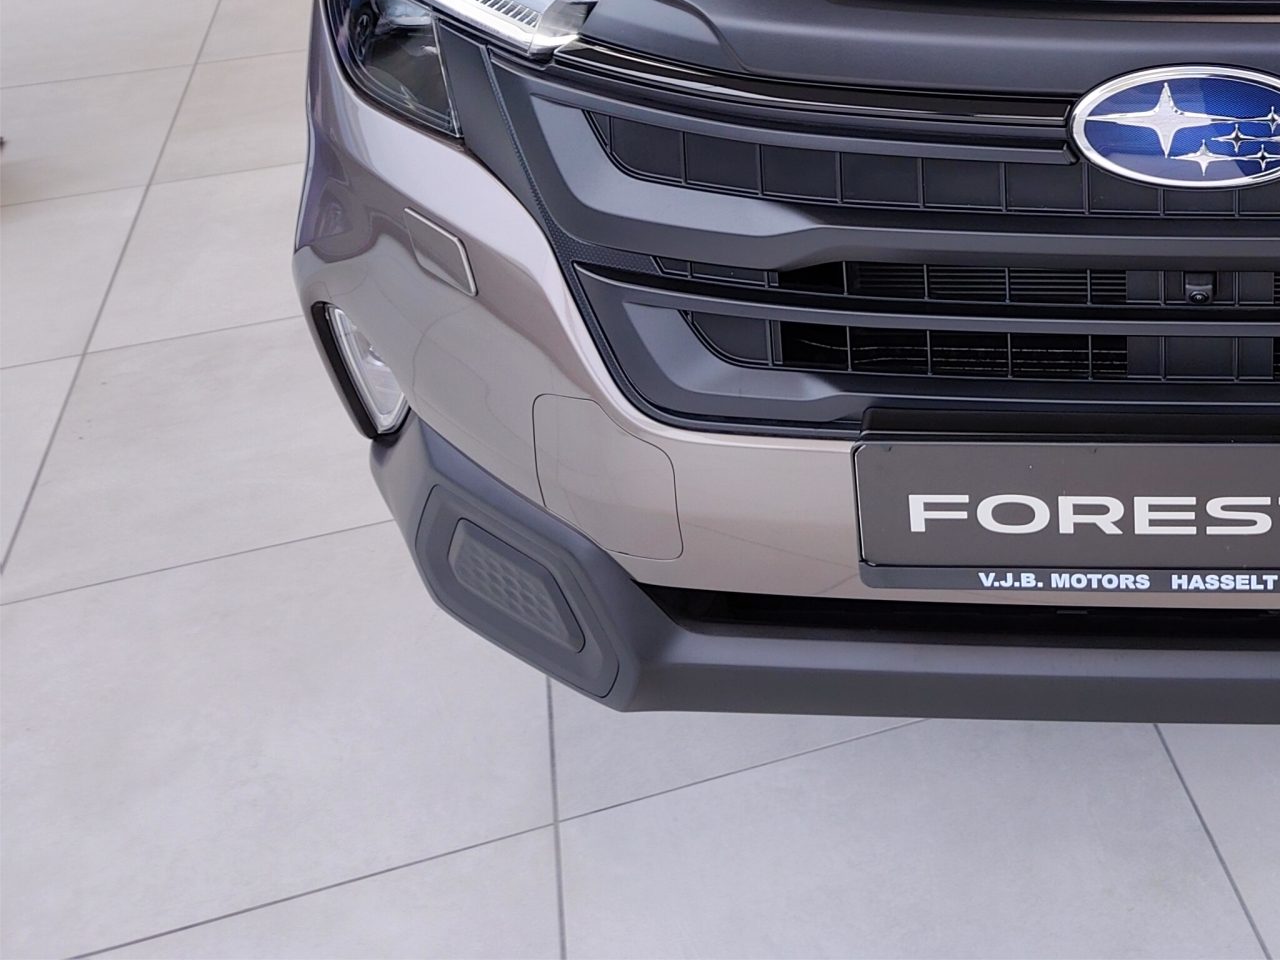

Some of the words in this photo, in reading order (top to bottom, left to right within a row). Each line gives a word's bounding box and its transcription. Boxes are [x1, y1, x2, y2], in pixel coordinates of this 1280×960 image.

[978, 572, 1044, 588] V.J.B.
[1050, 573, 1151, 590] MOTORS
[1171, 574, 1278, 590] HASSELT
